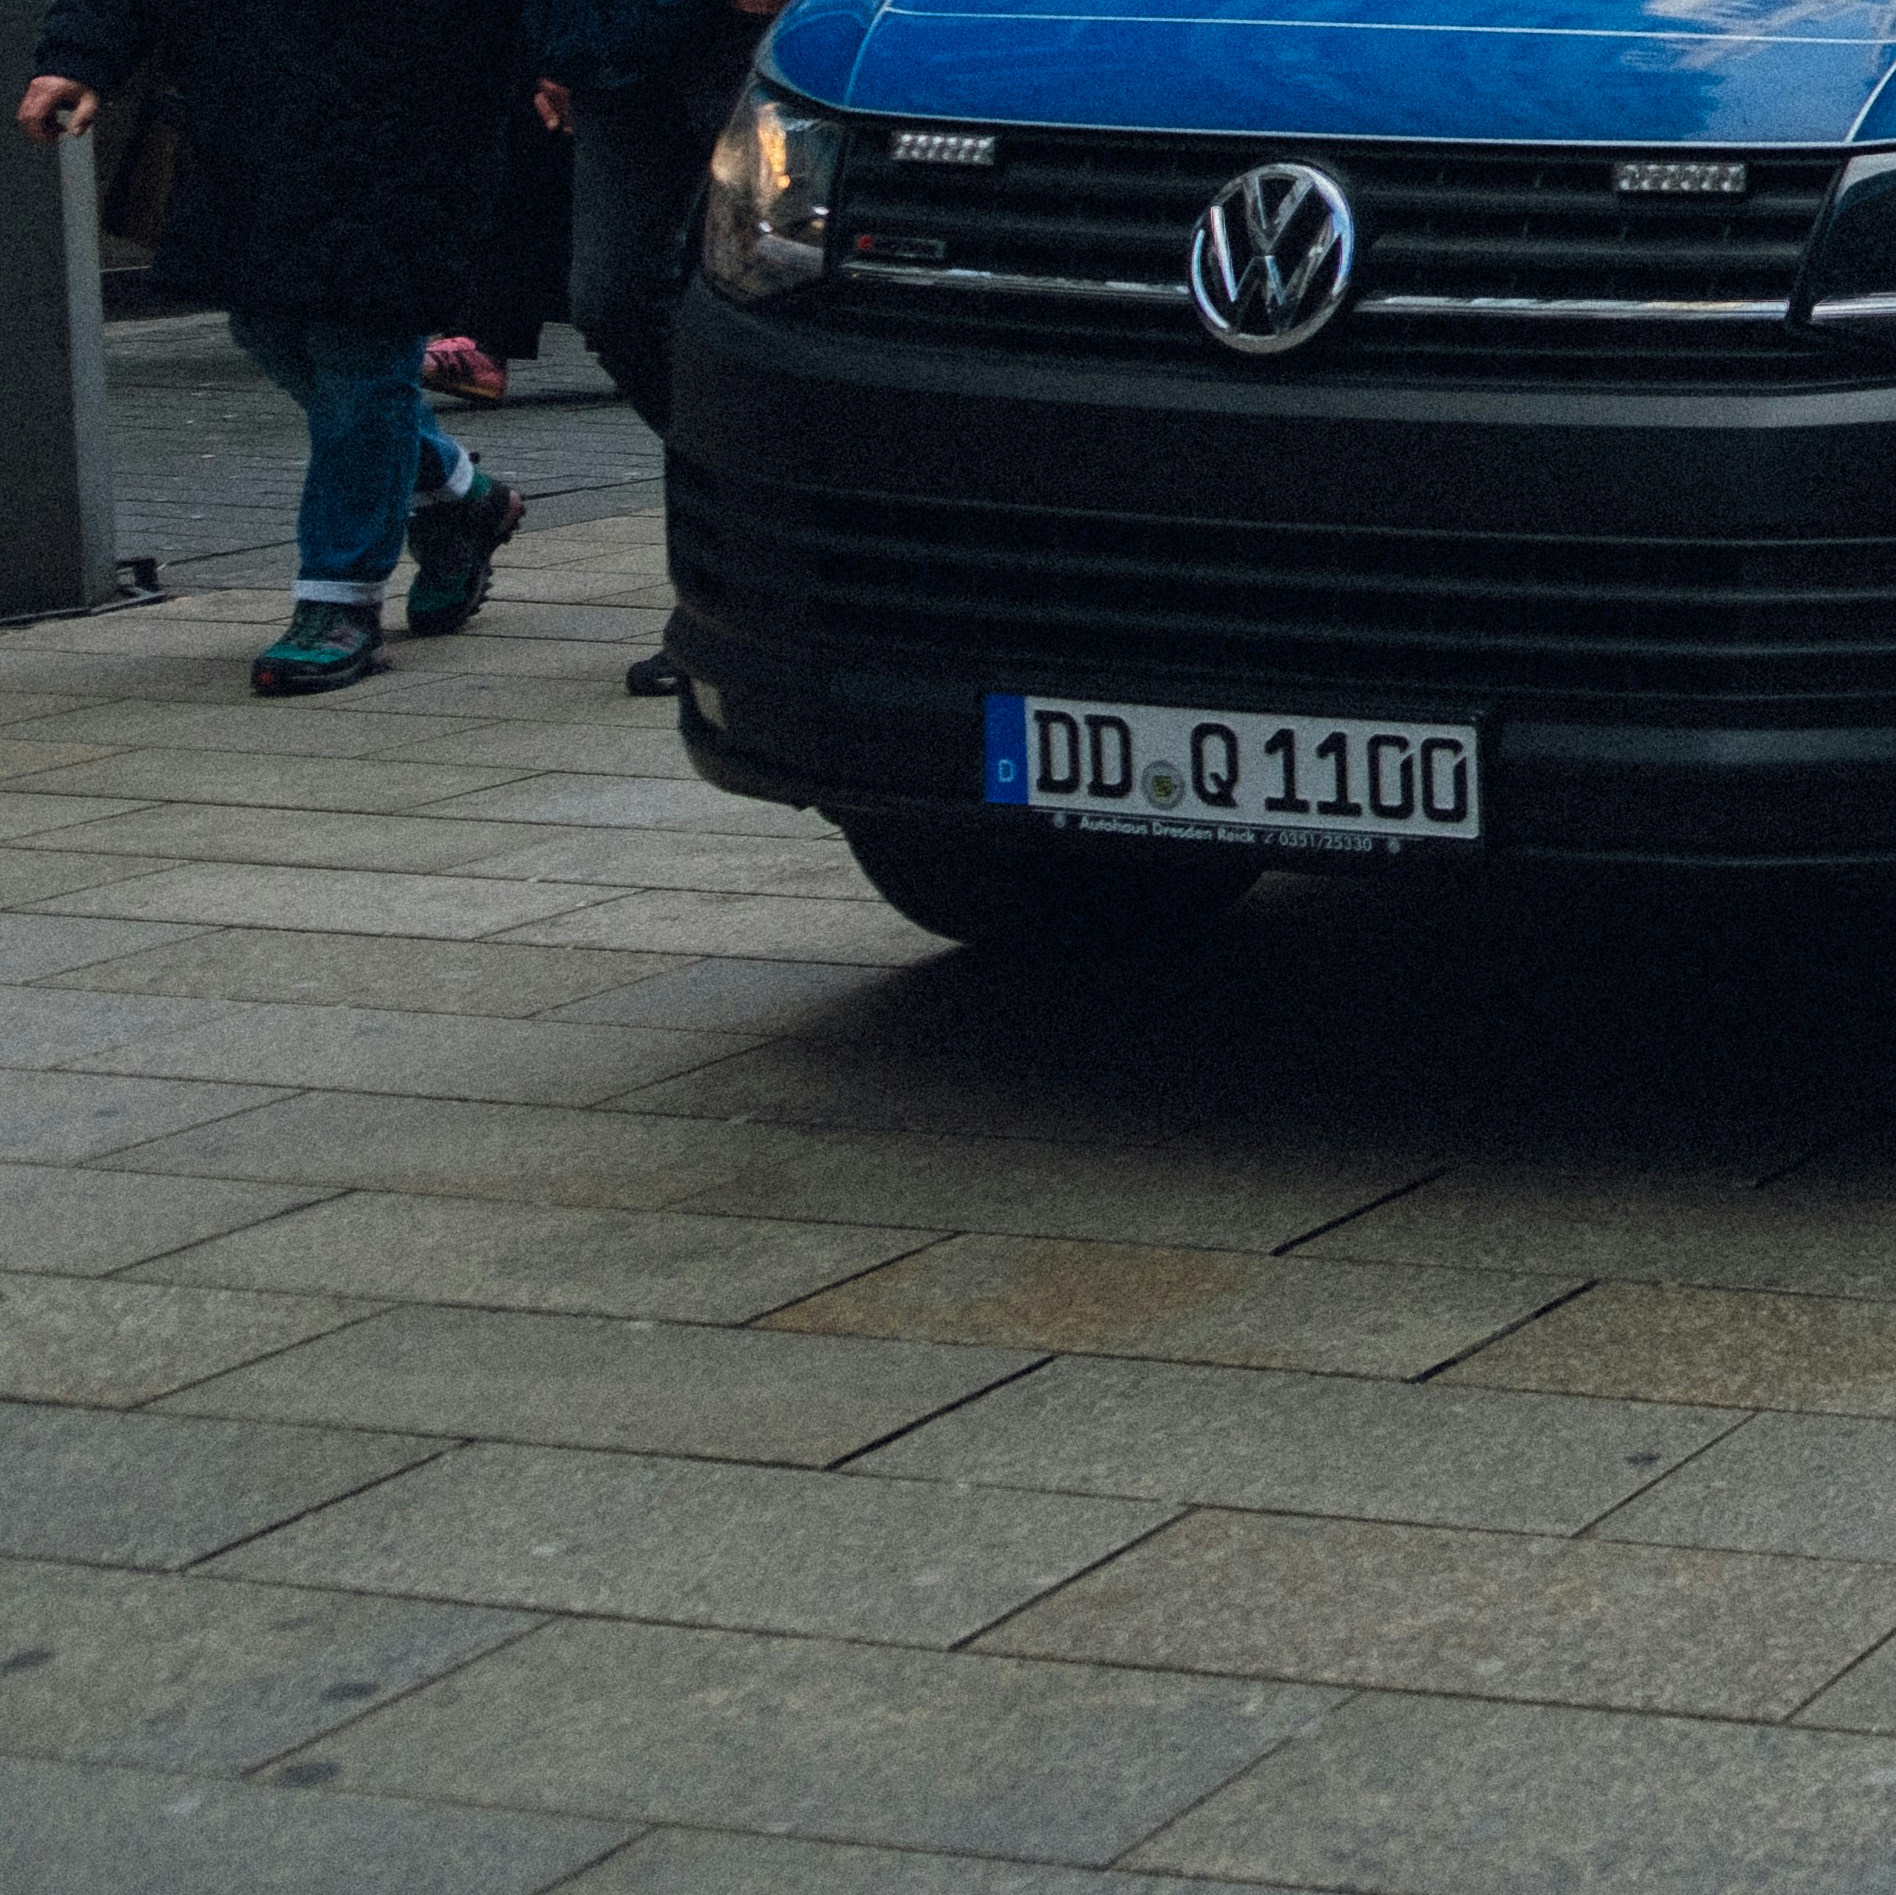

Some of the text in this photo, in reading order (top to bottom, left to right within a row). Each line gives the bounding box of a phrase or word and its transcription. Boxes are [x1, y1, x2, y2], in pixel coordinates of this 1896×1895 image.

[998, 759, 1015, 783] D
[1034, 708, 1468, 824] DD Q 1100
[1080, 815, 1148, 835] Autohaus
[1152, 821, 1212, 841] Dresden
